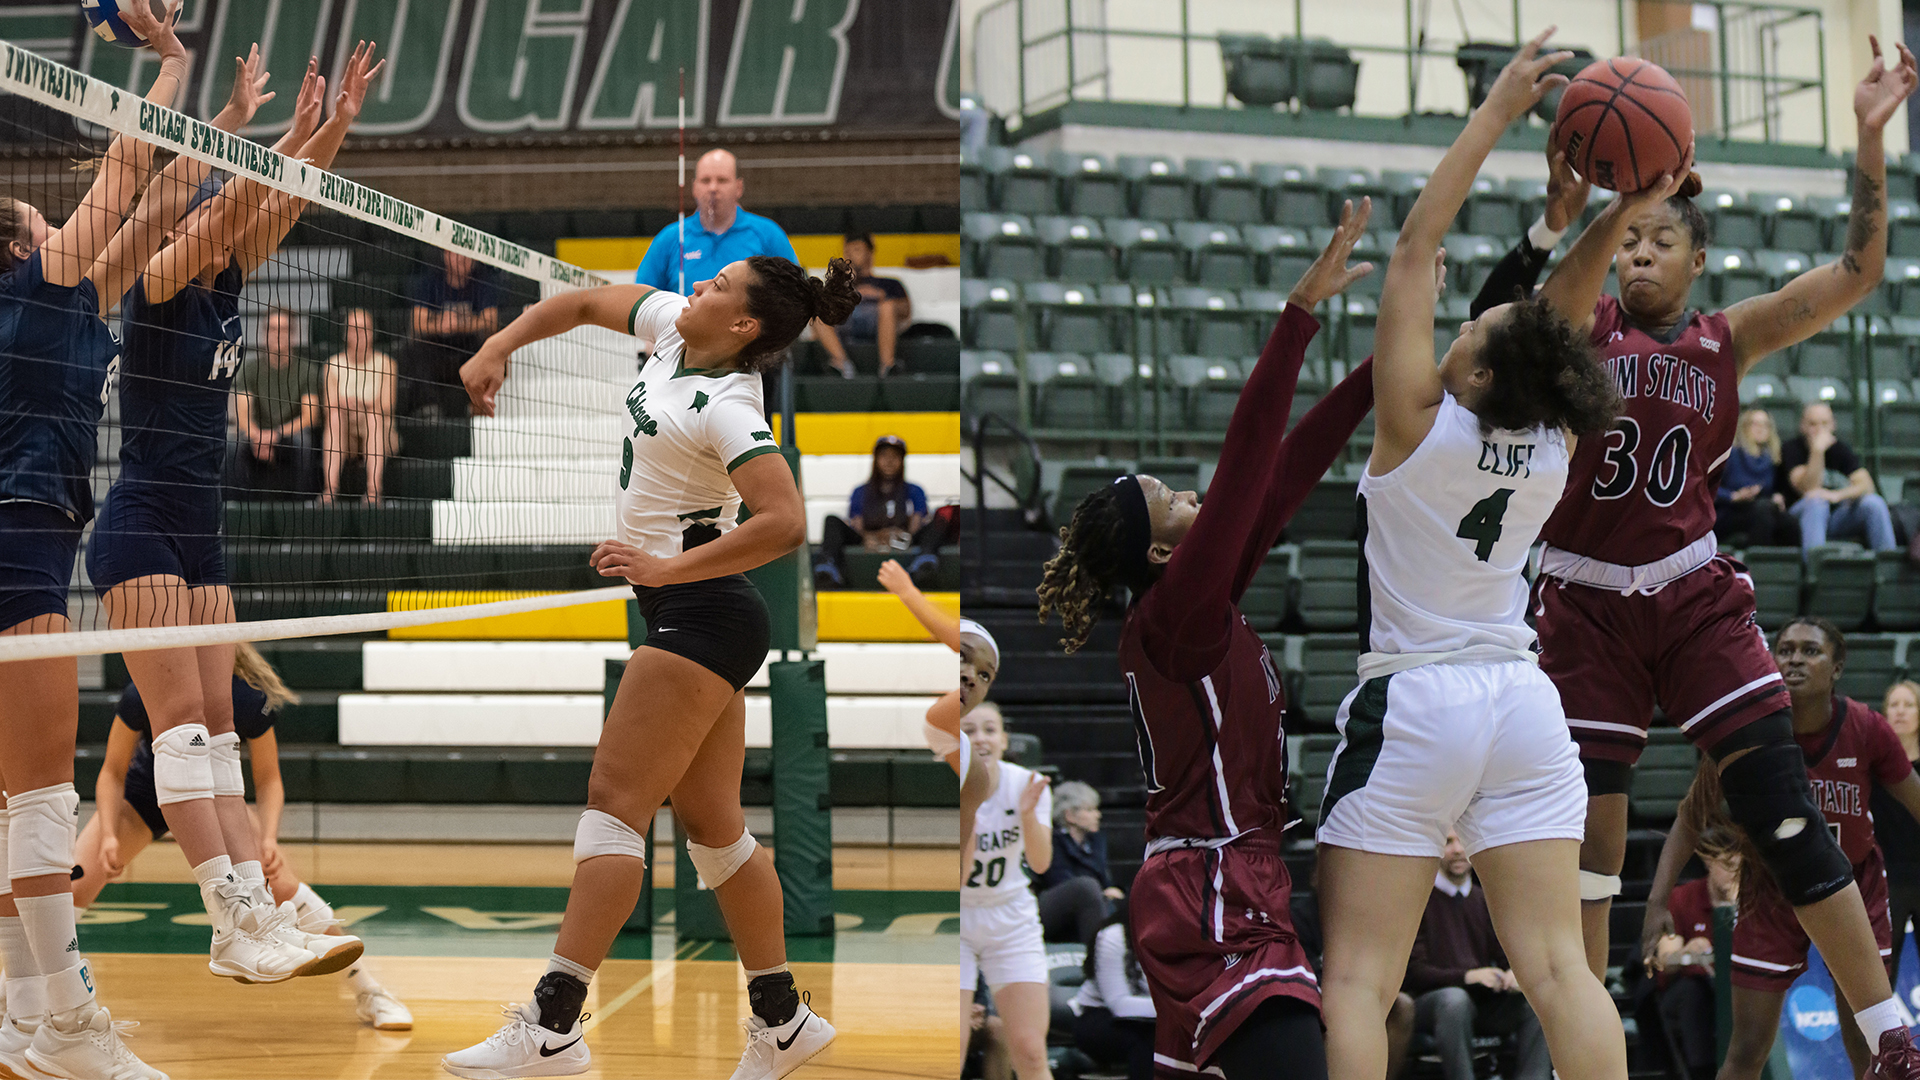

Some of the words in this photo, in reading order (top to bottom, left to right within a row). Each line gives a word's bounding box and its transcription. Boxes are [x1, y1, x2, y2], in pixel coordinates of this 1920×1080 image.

[6, 45, 88, 107] UNIVERSITY
[191, 120, 225, 159] STATE
[207, 335, 243, 381] 14
[1644, 353, 1716, 425] STATE
[619, 436, 634, 491] 9
[1591, 416, 1692, 508] 30
[1457, 487, 1516, 563] 4
[1810, 779, 1862, 816] TATE
[976, 825, 1020, 852] GARS
[966, 856, 1006, 888] 20
